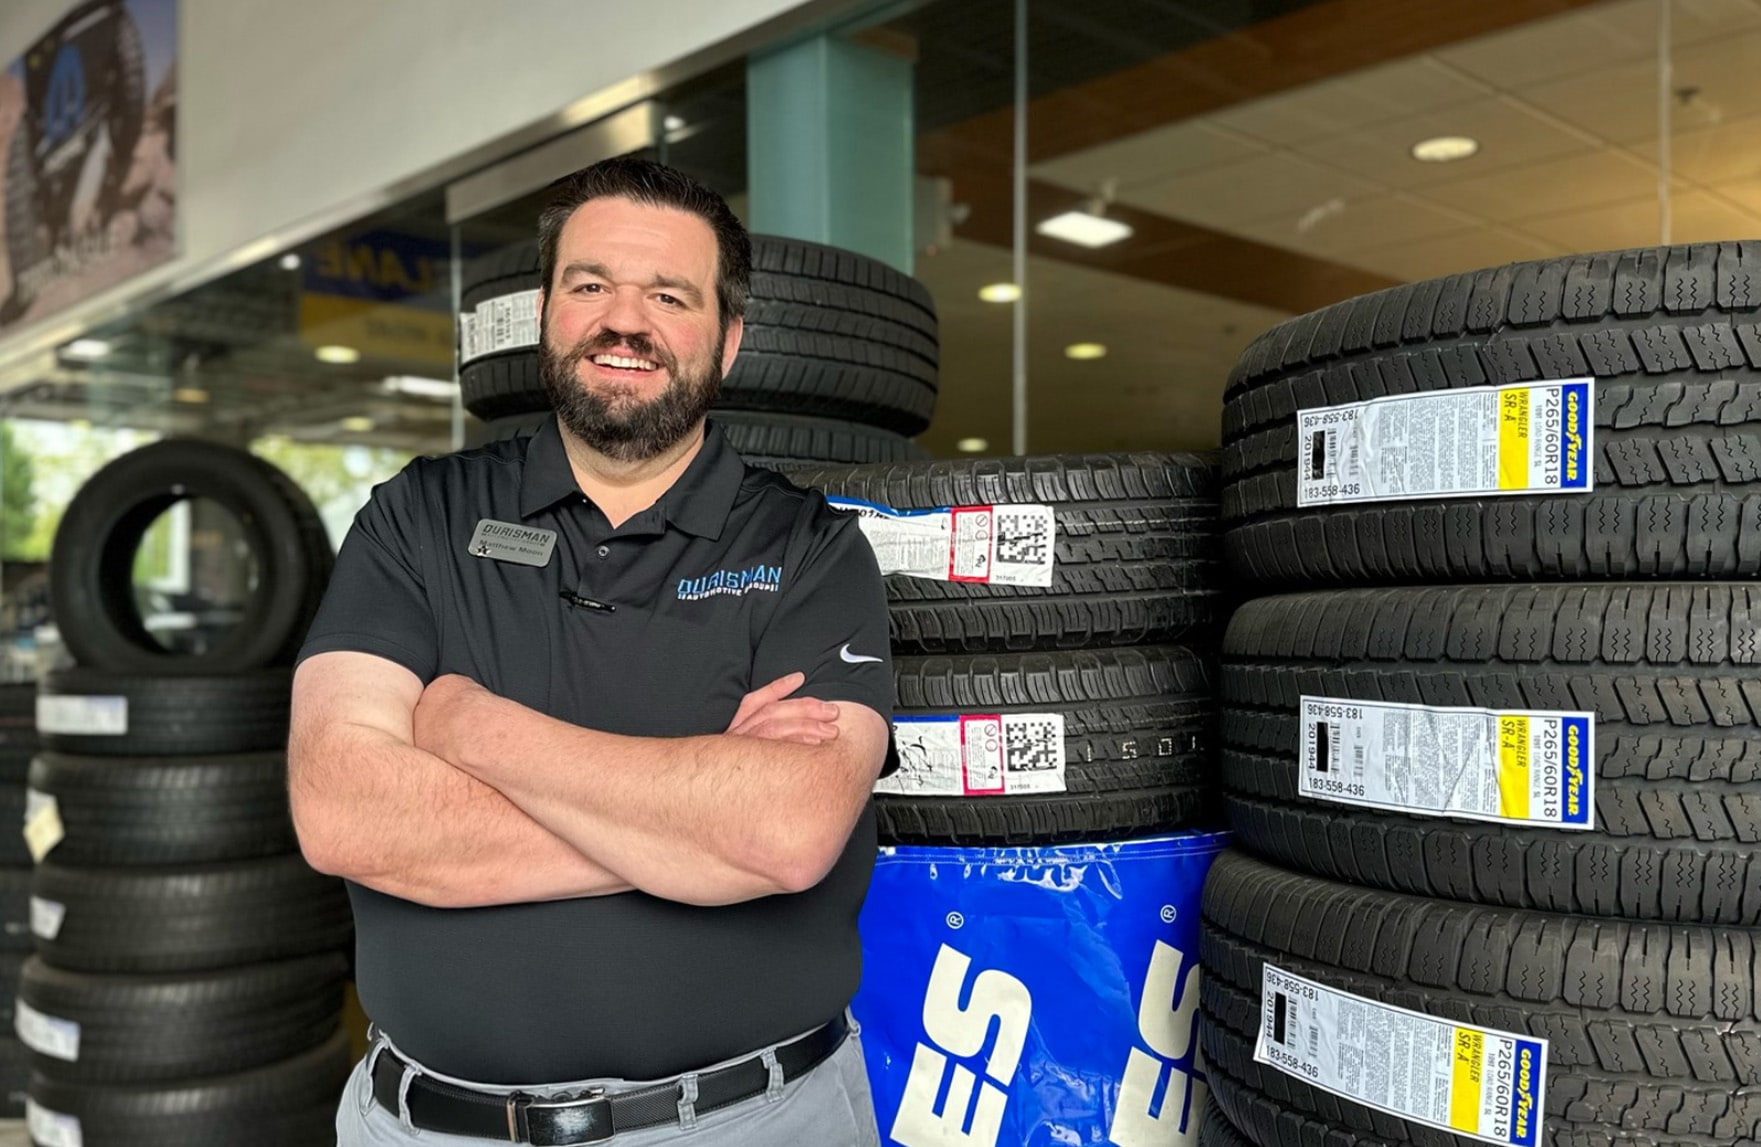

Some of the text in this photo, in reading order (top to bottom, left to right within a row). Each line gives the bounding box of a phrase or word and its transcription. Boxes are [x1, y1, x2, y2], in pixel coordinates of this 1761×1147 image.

[1503, 393, 1517, 422] SR-A
[1517, 391, 1529, 438] WRANGLER
[1303, 434, 1312, 481] 201944
[1544, 388, 1560, 485] P265/60R18
[1566, 391, 1582, 481] GOODYEAR
[483, 524, 551, 543] OURISMAN
[677, 564, 783, 593] OURISMAN
[686, 587, 742, 600] AUTOMOTIVE
[1308, 722, 1316, 770] 201944
[1501, 719, 1516, 750] SR-A
[1516, 719, 1527, 768] WRANGLER
[1308, 777, 1365, 796] 183-558-436
[1544, 719, 1558, 817] P265/60R18
[1567, 724, 1583, 815] GOODYEAR
[1265, 972, 1319, 1001] 183-558-436
[1265, 990, 1274, 1039] 201944
[1265, 1044, 1320, 1078] 183-558-436
[1457, 1031, 1471, 1065] SR-A
[1470, 1034, 1482, 1083] WRANGLER
[1494, 1039, 1513, 1137] P265/60R18
[1516, 1048, 1533, 1138] GOODYEAR
